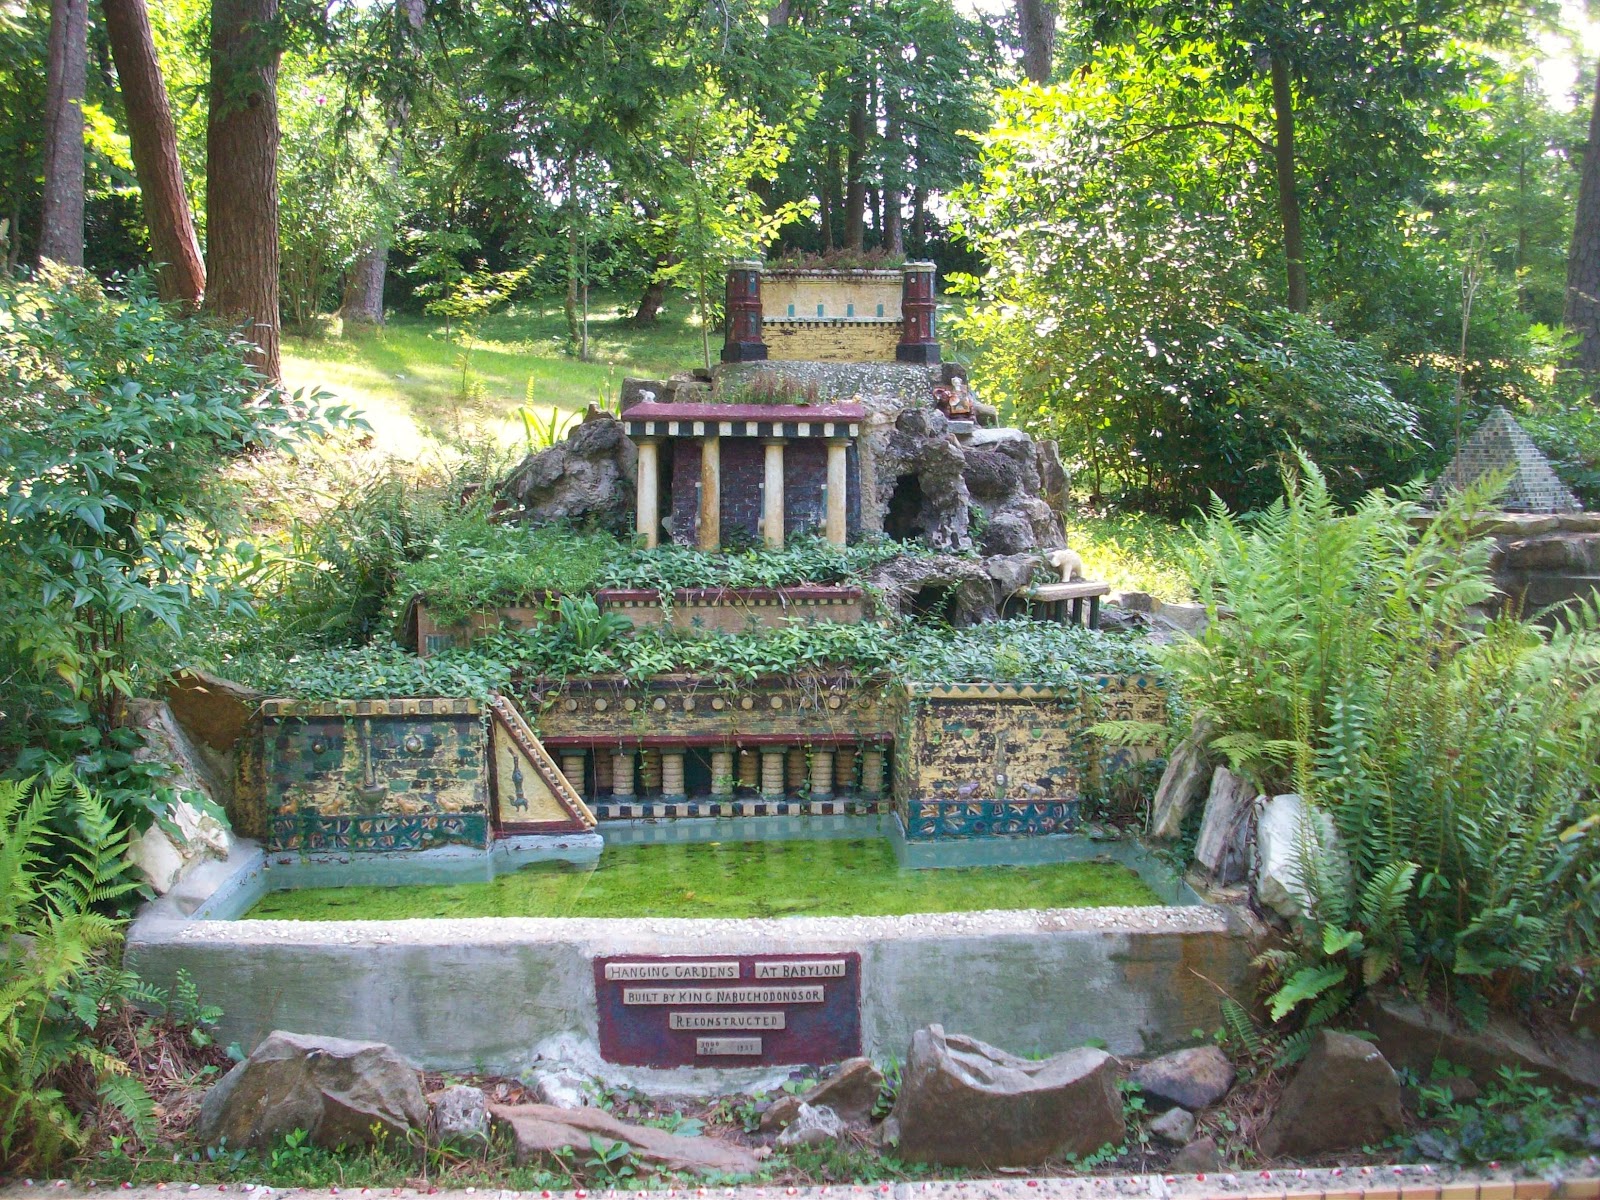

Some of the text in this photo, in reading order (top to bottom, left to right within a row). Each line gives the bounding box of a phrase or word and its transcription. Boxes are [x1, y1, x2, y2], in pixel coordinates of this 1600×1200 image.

[611, 964, 841, 979] HANGING GARDENS AT BABYLON
[627, 990, 821, 1003] BUILT BY KING NABUCHODONOSOR
[676, 1015, 778, 1028] RECONSTRUCTED
